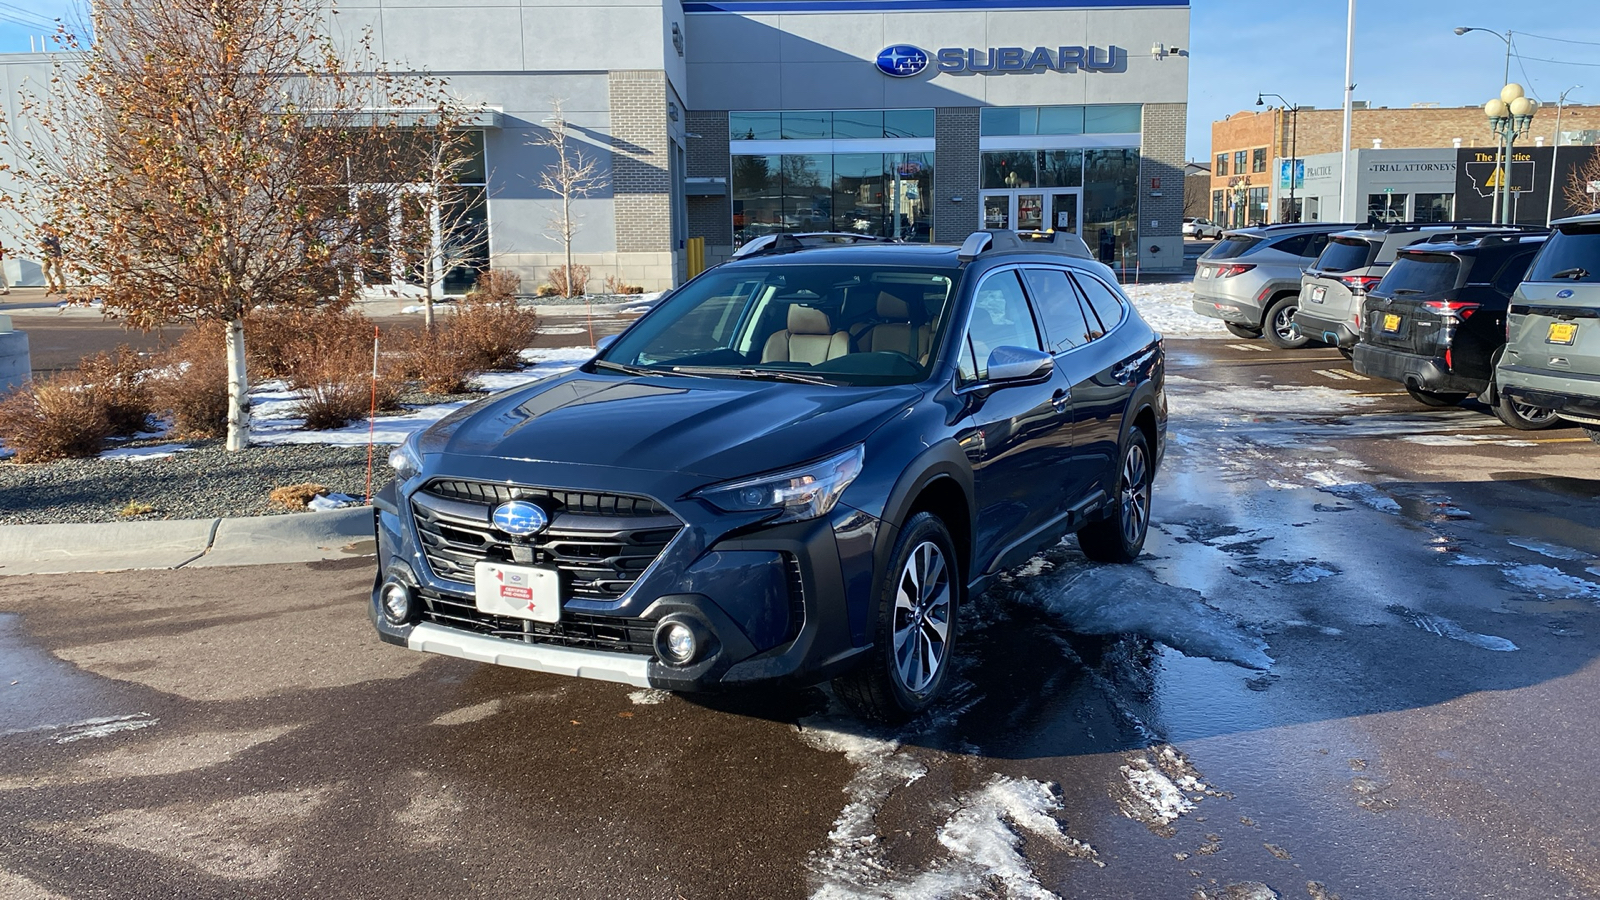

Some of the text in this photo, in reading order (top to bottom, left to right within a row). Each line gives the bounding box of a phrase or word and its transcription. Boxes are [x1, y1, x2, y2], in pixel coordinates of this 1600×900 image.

[937, 45, 1116, 71] SUBARU
[1475, 152, 1531, 161] The rtice
[1307, 166, 1332, 177] PRACTICE
[1403, 163, 1456, 171] ATTORNEYS
